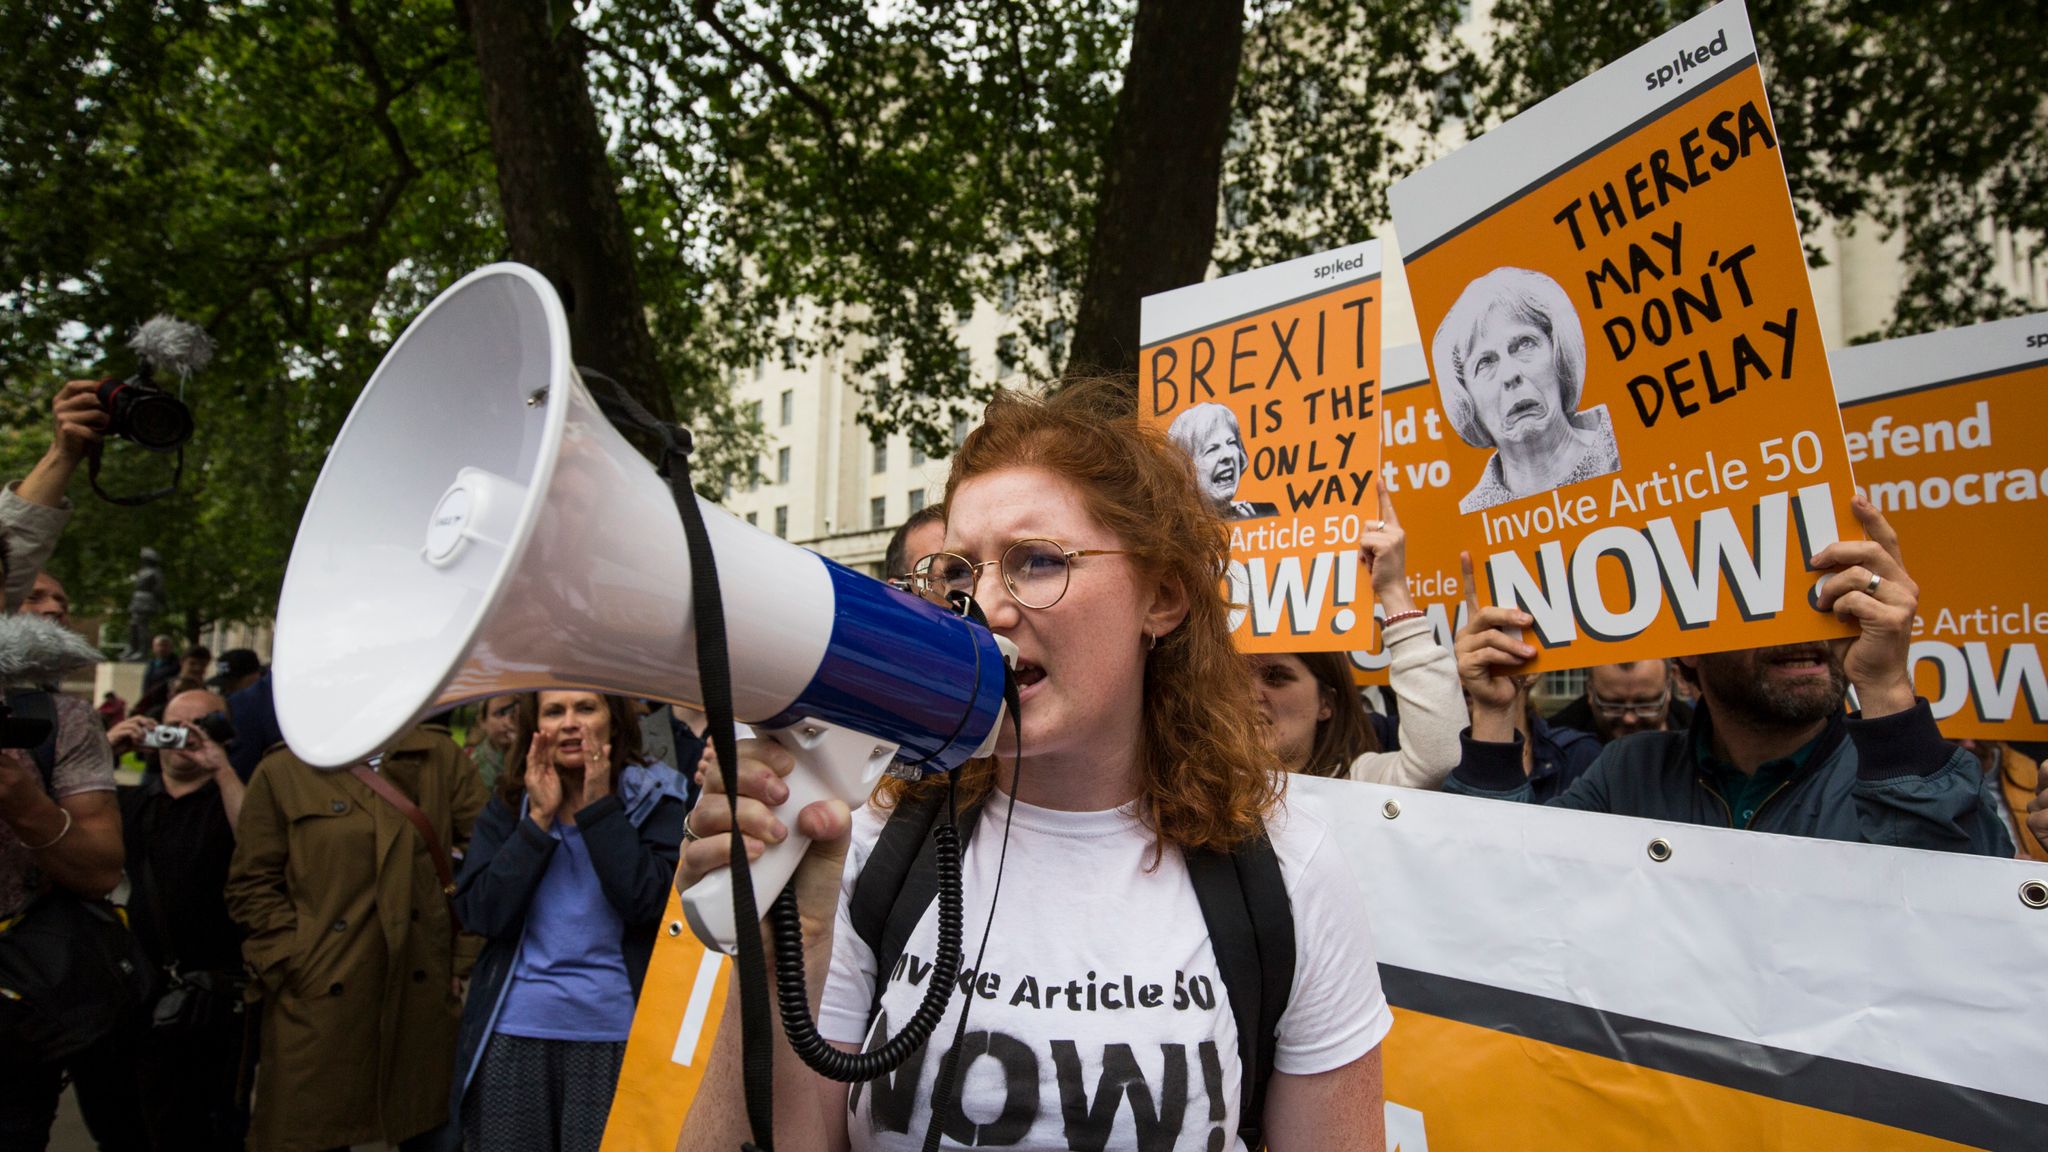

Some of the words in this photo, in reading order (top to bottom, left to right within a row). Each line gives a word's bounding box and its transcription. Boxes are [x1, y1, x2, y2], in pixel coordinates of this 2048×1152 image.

[1553, 100, 1776, 251] THERESA
[1585, 221, 1682, 309] MAY
[1603, 244, 1756, 362] DON'T
[1152, 297, 1373, 417] BREXIT
[1626, 308, 1798, 428] DELAY
[1250, 400, 1282, 438] IS
[1304, 380, 1374, 424] THE
[1254, 432, 1356, 480] ONLY
[1286, 471, 1373, 512] WAY
[1405, 460, 1450, 490] vo
[1481, 490, 1599, 545] Invoke
[1609, 451, 1749, 518] Article
[1760, 430, 1823, 482] 50
[1230, 518, 1316, 552] Article
[1324, 514, 1359, 545] 50
[1487, 482, 1840, 648] NOW!
[1933, 602, 2048, 636] Article
[1009, 970, 1163, 1011] Article
[1173, 970, 1215, 1011] 50
[849, 1031, 1226, 1152] NOW!
